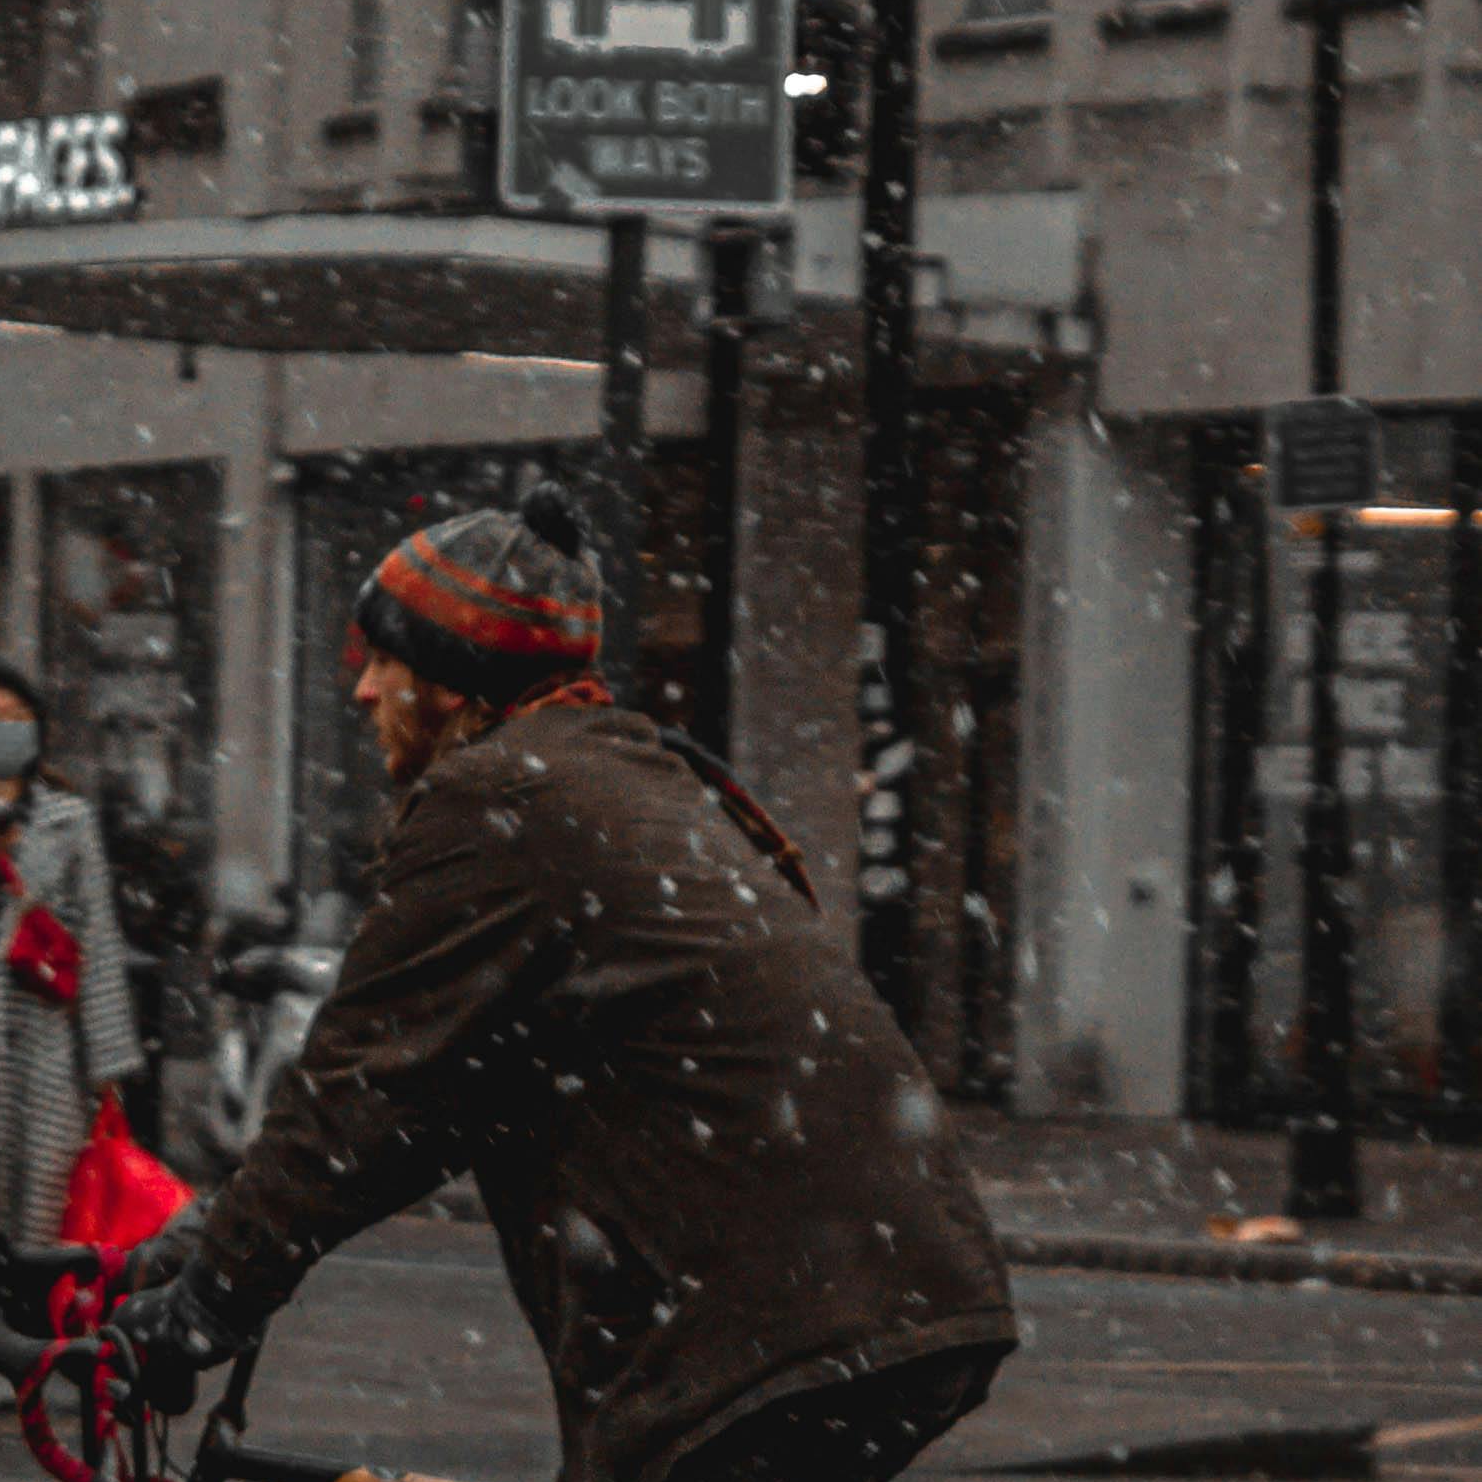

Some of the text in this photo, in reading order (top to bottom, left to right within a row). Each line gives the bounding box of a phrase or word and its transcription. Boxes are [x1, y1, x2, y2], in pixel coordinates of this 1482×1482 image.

[524, 75, 770, 127] LOOK BOTH
[589, 134, 710, 185] WAYS
